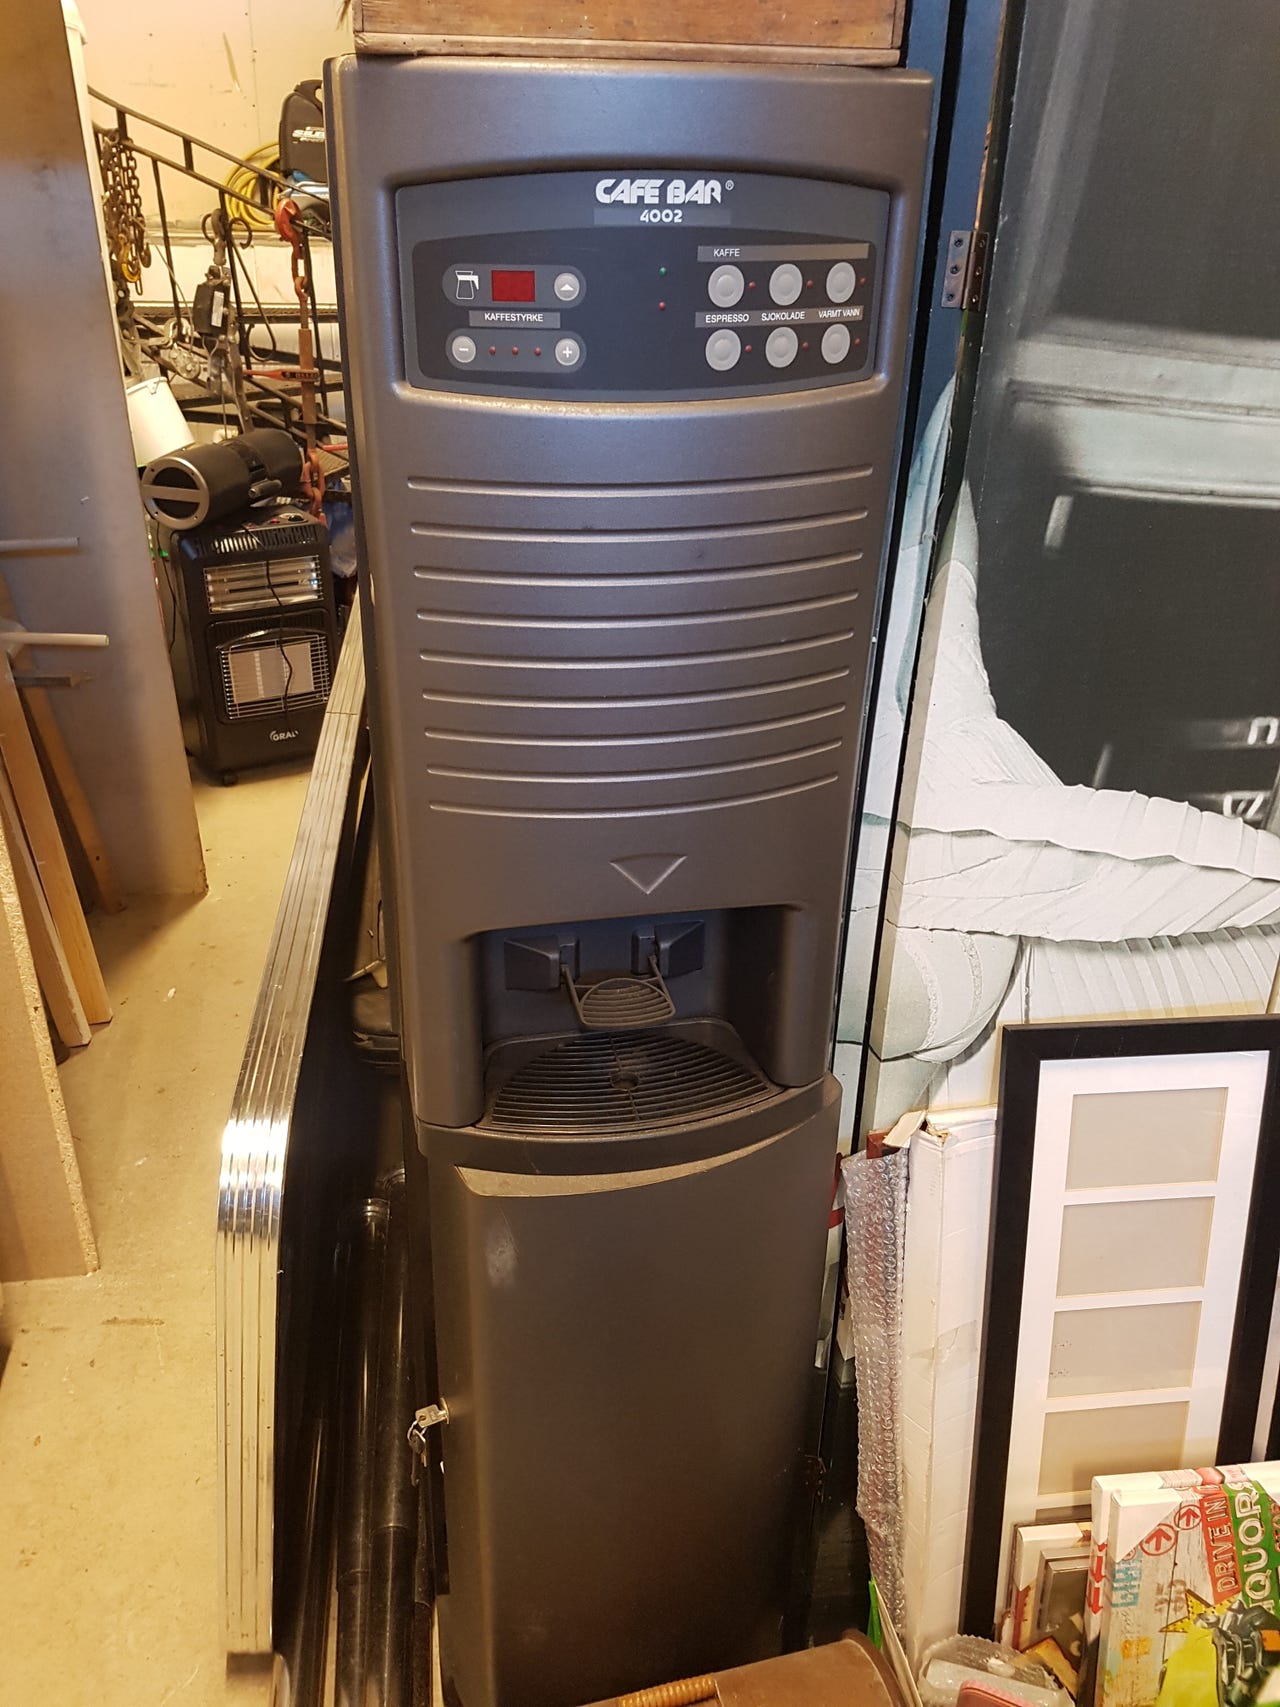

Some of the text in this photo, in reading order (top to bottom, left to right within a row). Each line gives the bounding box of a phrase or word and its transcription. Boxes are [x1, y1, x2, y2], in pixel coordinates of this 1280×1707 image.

[595, 178, 664, 204] CAFE
[639, 209, 683, 223] 4002
[713, 248, 740, 257] KAFFE
[484, 312, 543, 322] KAFFESTYRKE
[705, 313, 750, 323] ESPRESSO
[761, 311, 806, 321] SJOKOLADE
[818, 308, 861, 319] VARMT VANN
[1204, 1498, 1238, 1593] DRIVE IN
